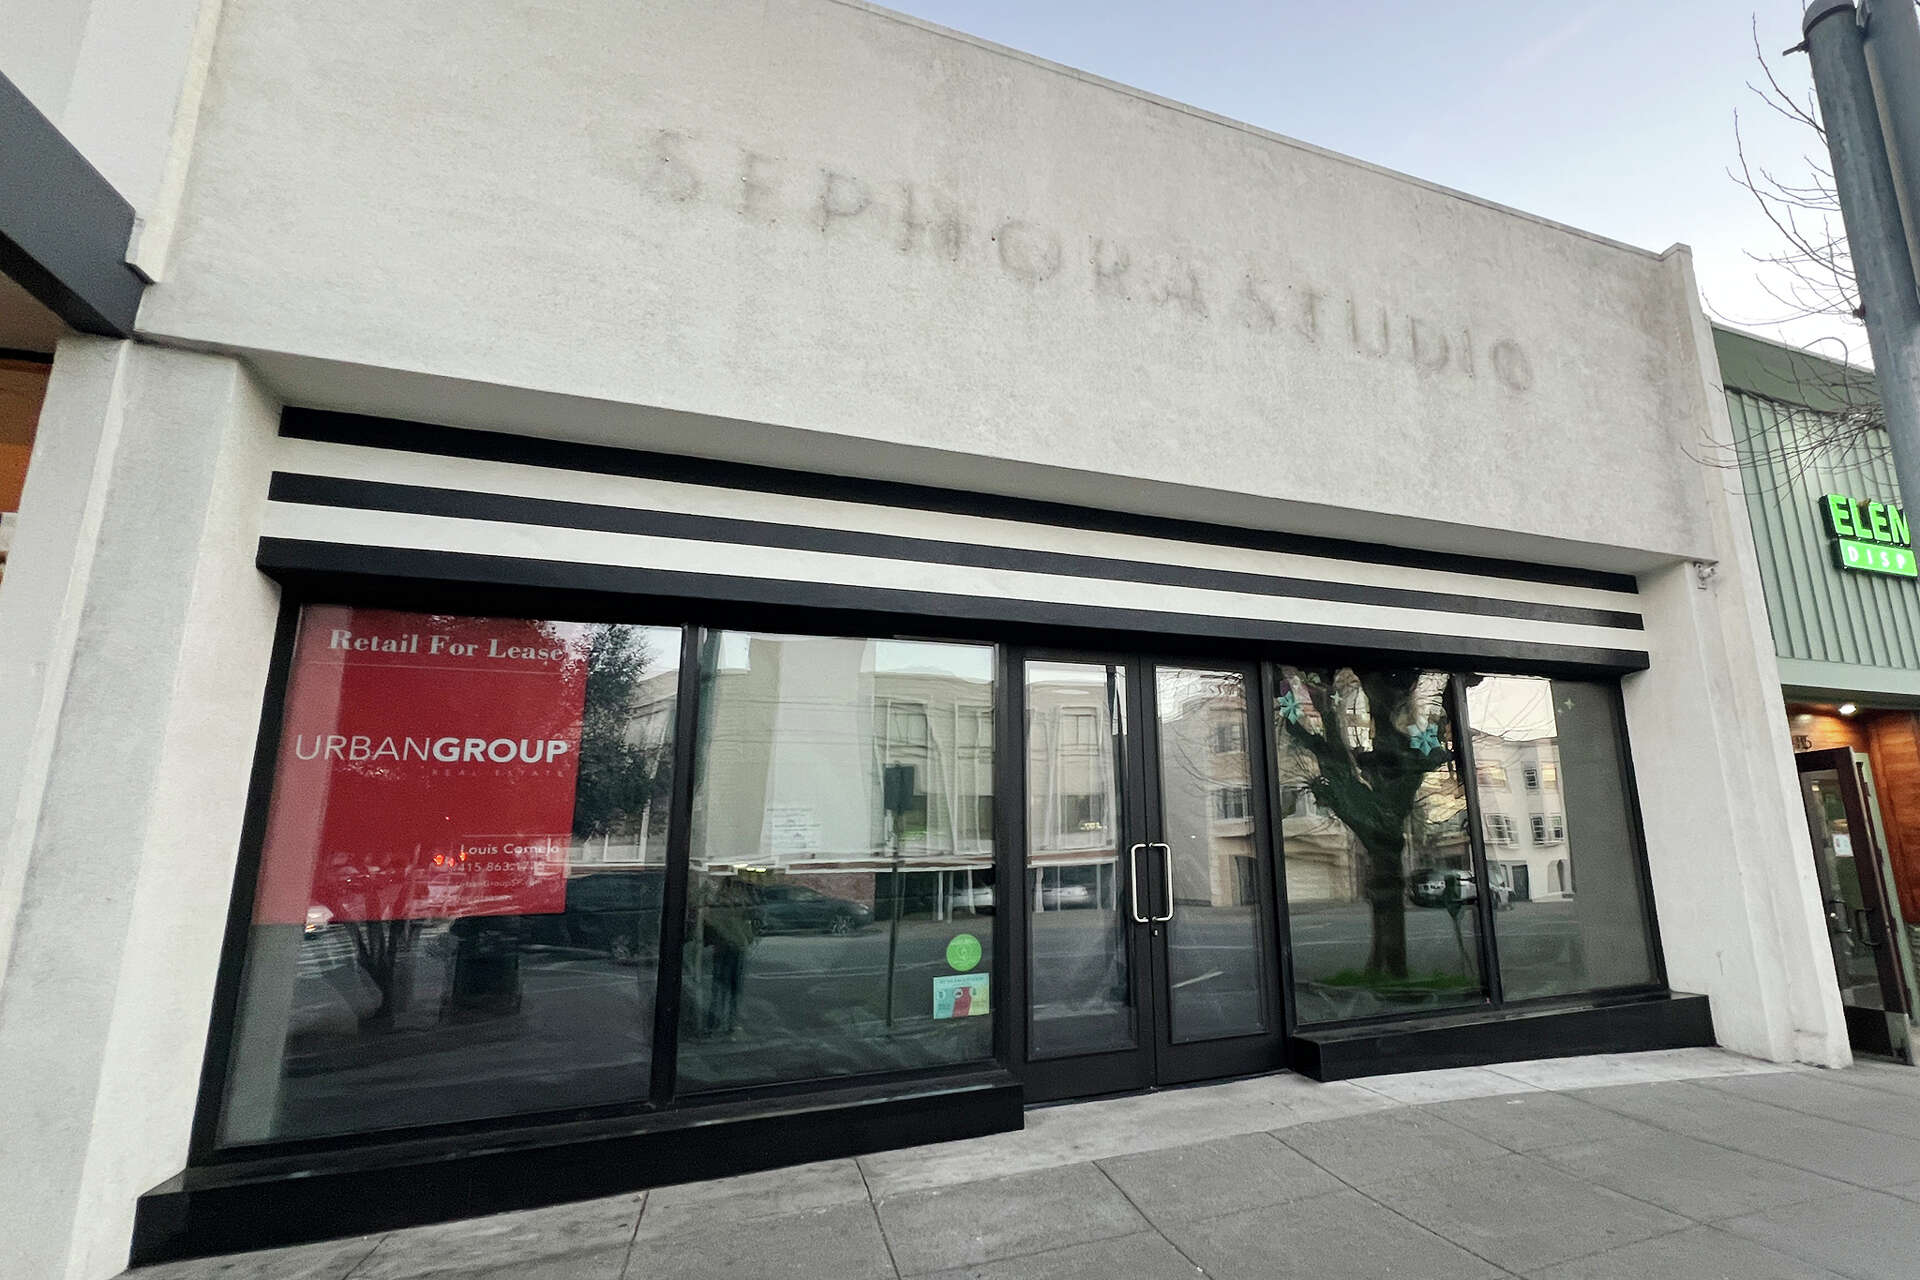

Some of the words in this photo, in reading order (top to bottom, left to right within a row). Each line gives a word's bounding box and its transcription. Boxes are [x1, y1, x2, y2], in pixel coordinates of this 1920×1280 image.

[1239, 271, 1535, 393] STUDIO
[1847, 546, 1907, 569] DISP
[329, 629, 418, 654] Retail
[428, 633, 479, 657] For
[486, 638, 565, 661] Lease
[294, 734, 569, 763] URBANGROUP
[460, 843, 499, 856] Louis
